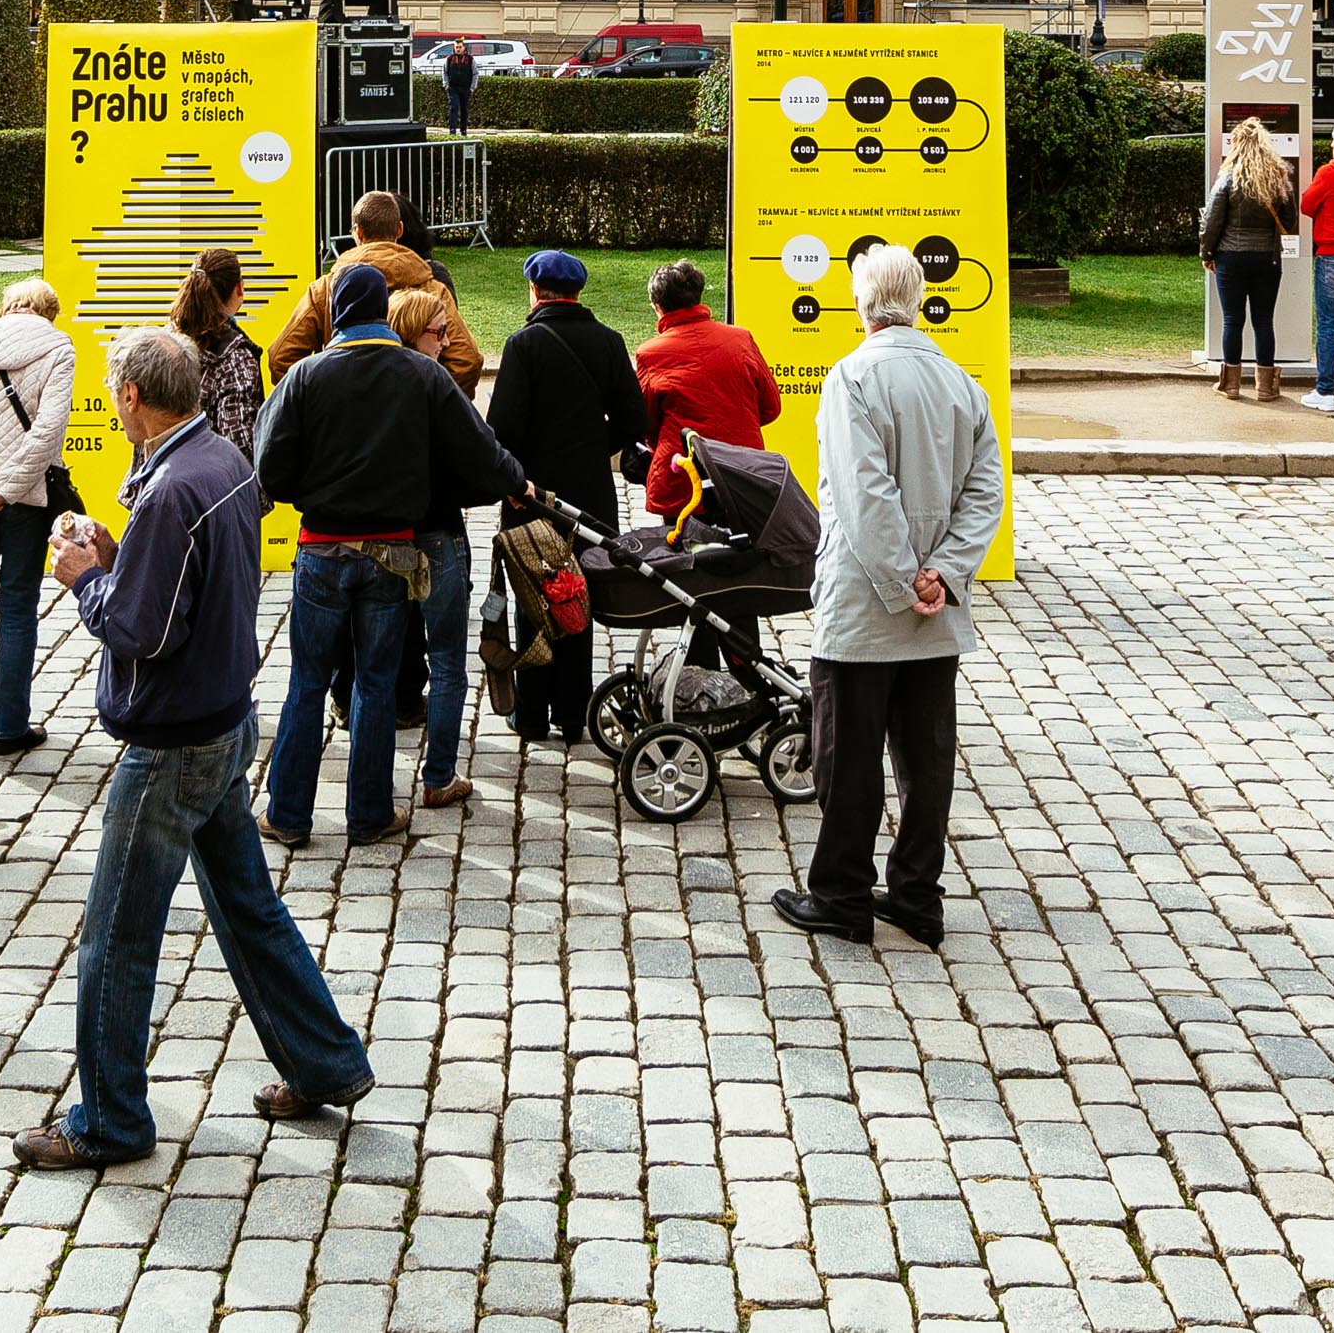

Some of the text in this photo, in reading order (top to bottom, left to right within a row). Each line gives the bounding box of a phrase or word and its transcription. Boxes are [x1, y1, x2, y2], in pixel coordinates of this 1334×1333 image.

[182, 50, 224, 64] Město
[793, 49, 823, 57] NEJVÍCE
[833, 49, 867, 57] NEJMÉNĚ
[870, 49, 904, 57] VYTÍŽENÉ
[73, 43, 166, 80] Znáte
[182, 69, 252, 87] v mapách,
[182, 85, 234, 106] grafech
[360, 87, 388, 97] SERVIS
[72, 84, 167, 122] Prahu
[182, 107, 243, 121] a číslech
[71, 130, 88, 163] ?
[248, 152, 283, 164] výstava
[808, 207, 838, 216] NEJVÍCE
[849, 207, 883, 216] NEJMÉNĚ
[886, 207, 920, 216] VYTÍŽENÉ
[924, 208, 960, 216] ZASTÁVKY
[923, 255, 932, 263] 57
[769, 364, 795, 377] očet
[84, 398, 106, 411] 10.
[65, 437, 103, 451] 2015
